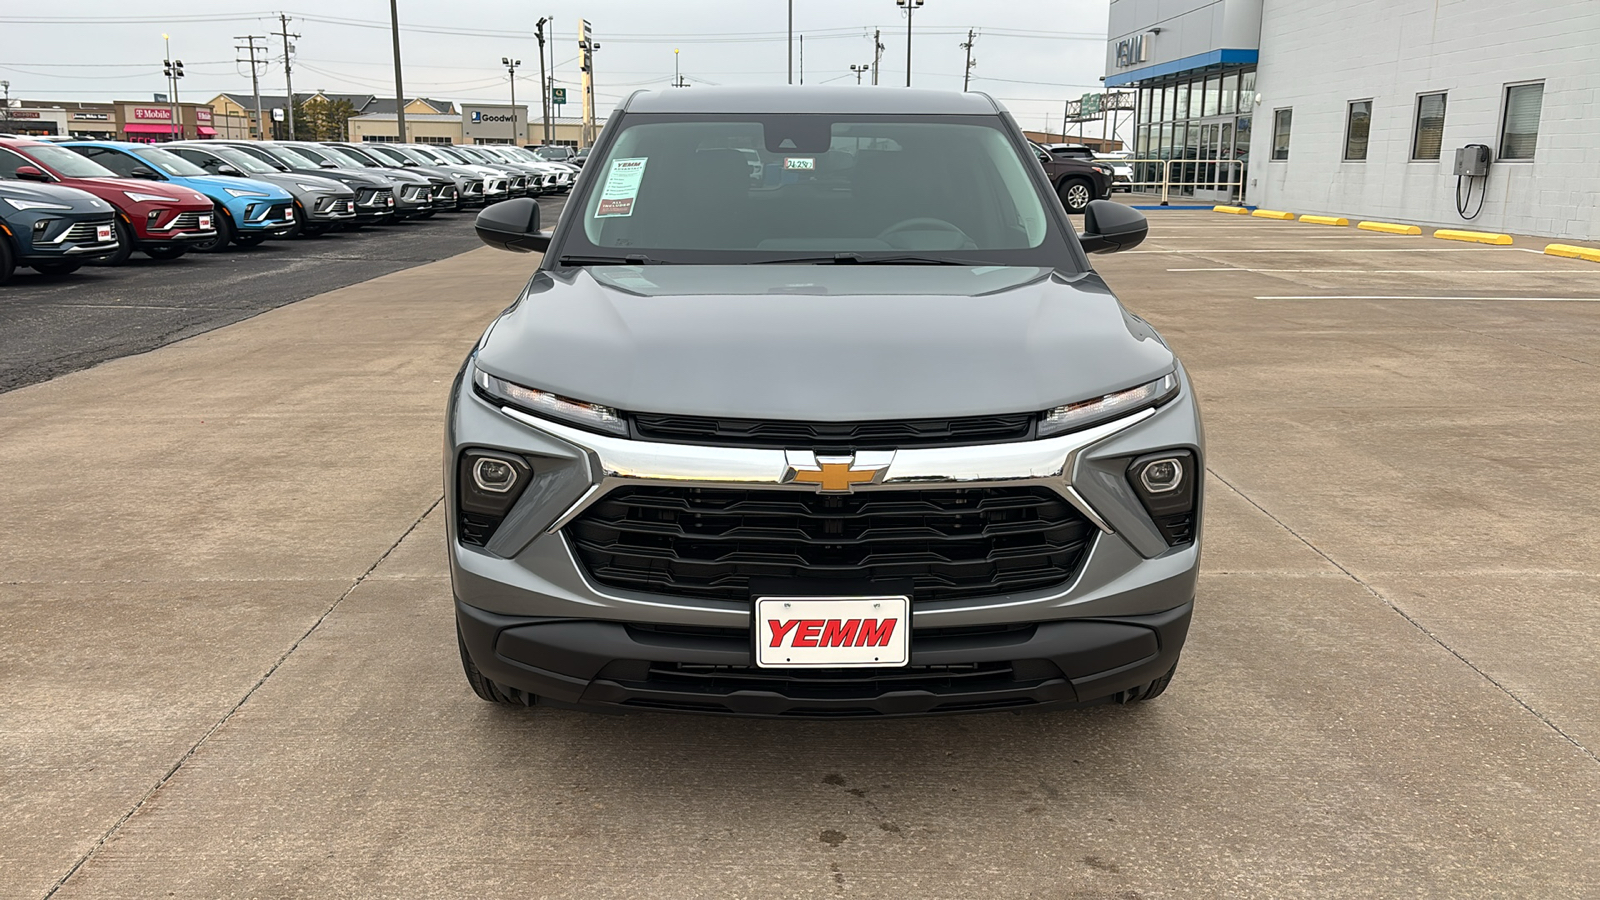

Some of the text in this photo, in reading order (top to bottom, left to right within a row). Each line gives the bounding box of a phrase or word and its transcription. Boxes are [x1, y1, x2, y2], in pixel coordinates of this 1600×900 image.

[144, 109, 170, 119] Mobile
[482, 114, 517, 122] Goodwil
[768, 618, 898, 648] YEMM
